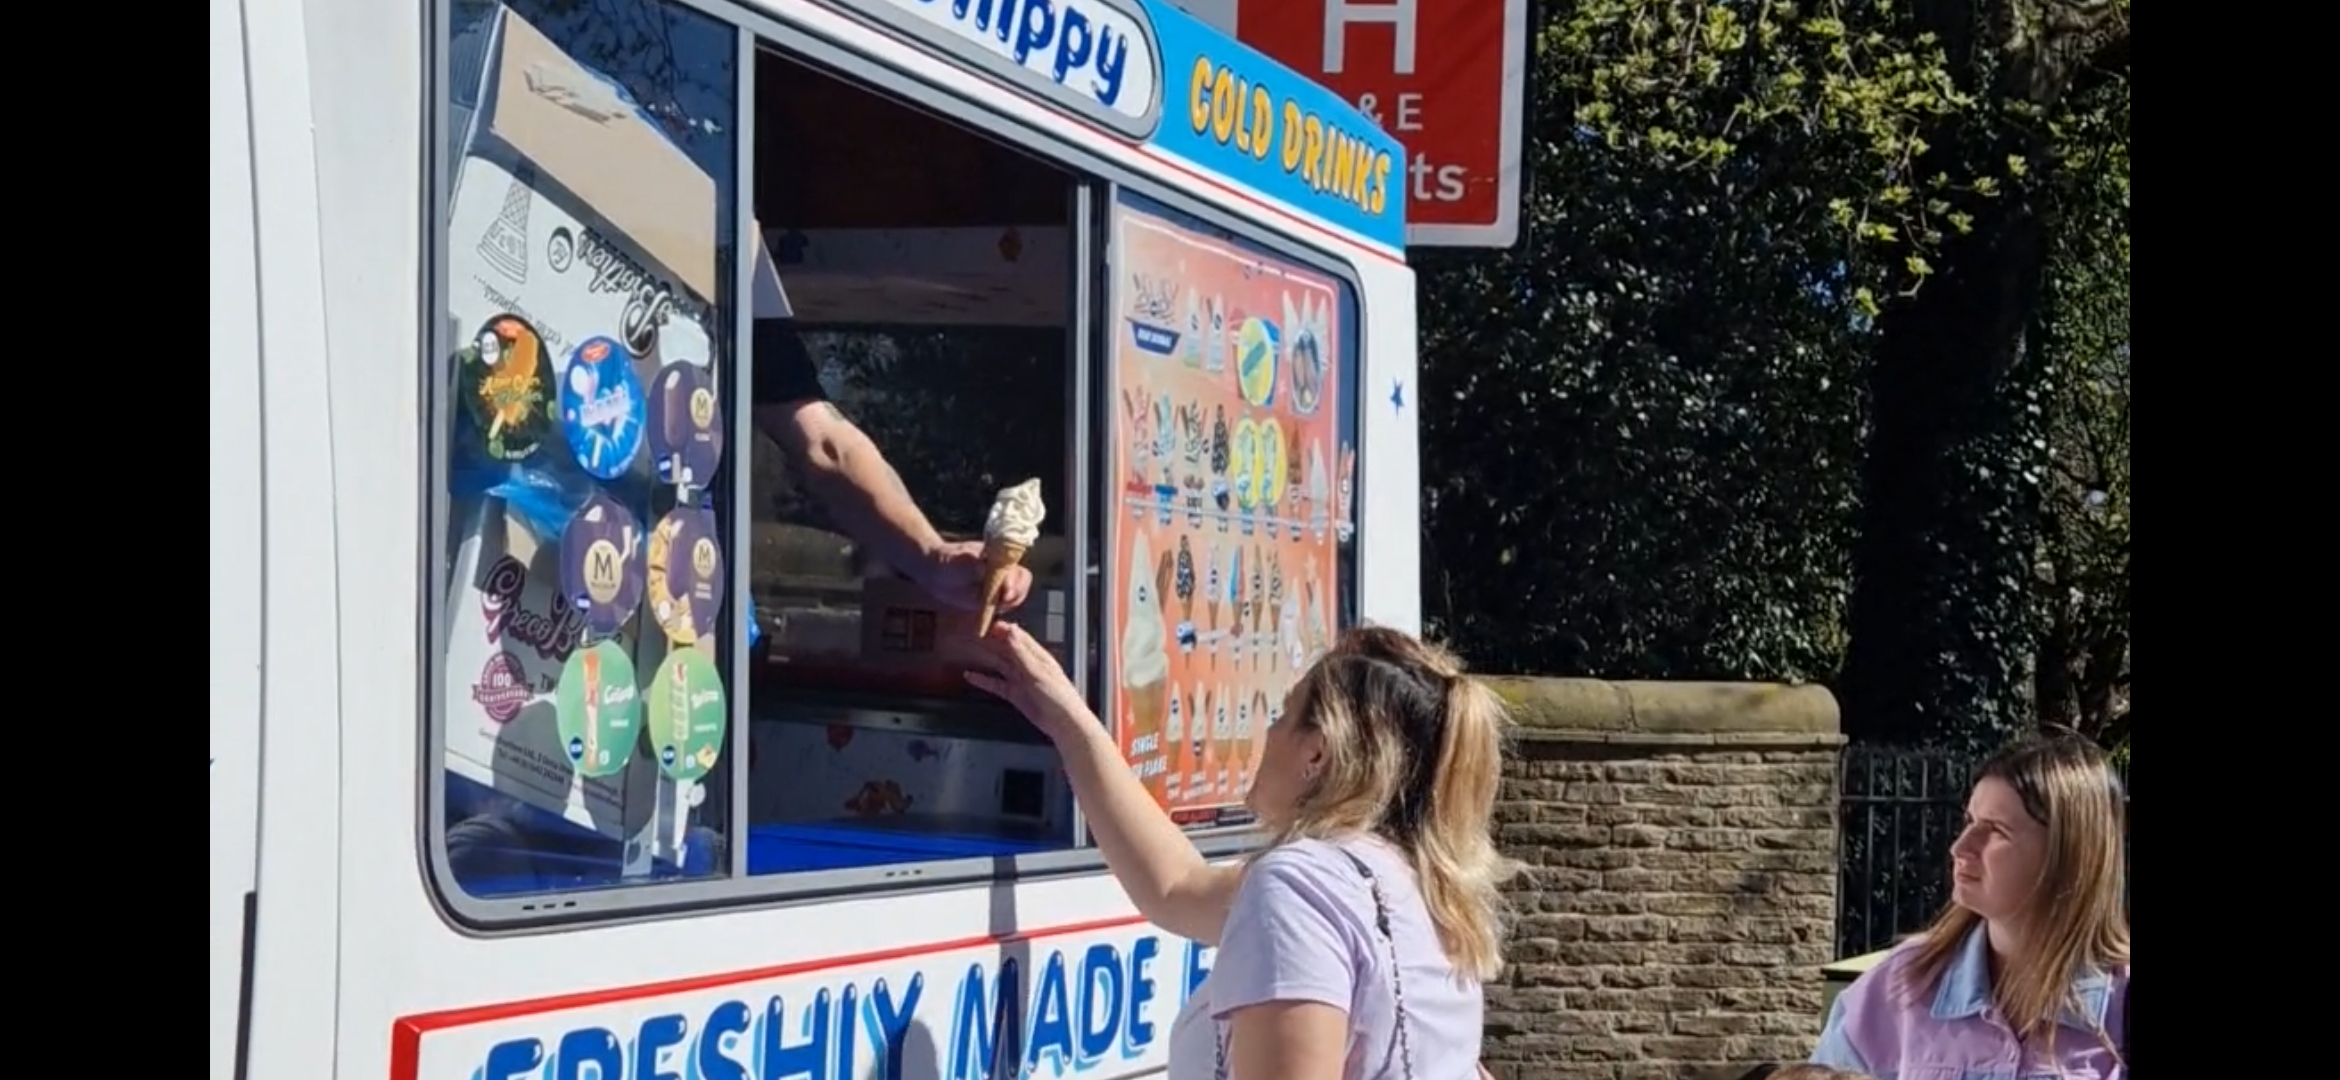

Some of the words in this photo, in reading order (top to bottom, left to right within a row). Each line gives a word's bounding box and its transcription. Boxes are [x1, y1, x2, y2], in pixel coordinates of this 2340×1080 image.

[917, 0, 1128, 106] ippy
[1323, 0, 1417, 73] H
[1189, 54, 1271, 160] COLD
[1281, 98, 1392, 215] DRINKS
[1397, 92, 1423, 131] E
[593, 551, 614, 582] M
[493, 672, 511, 688] 100
[952, 936, 1159, 1080] MADE
